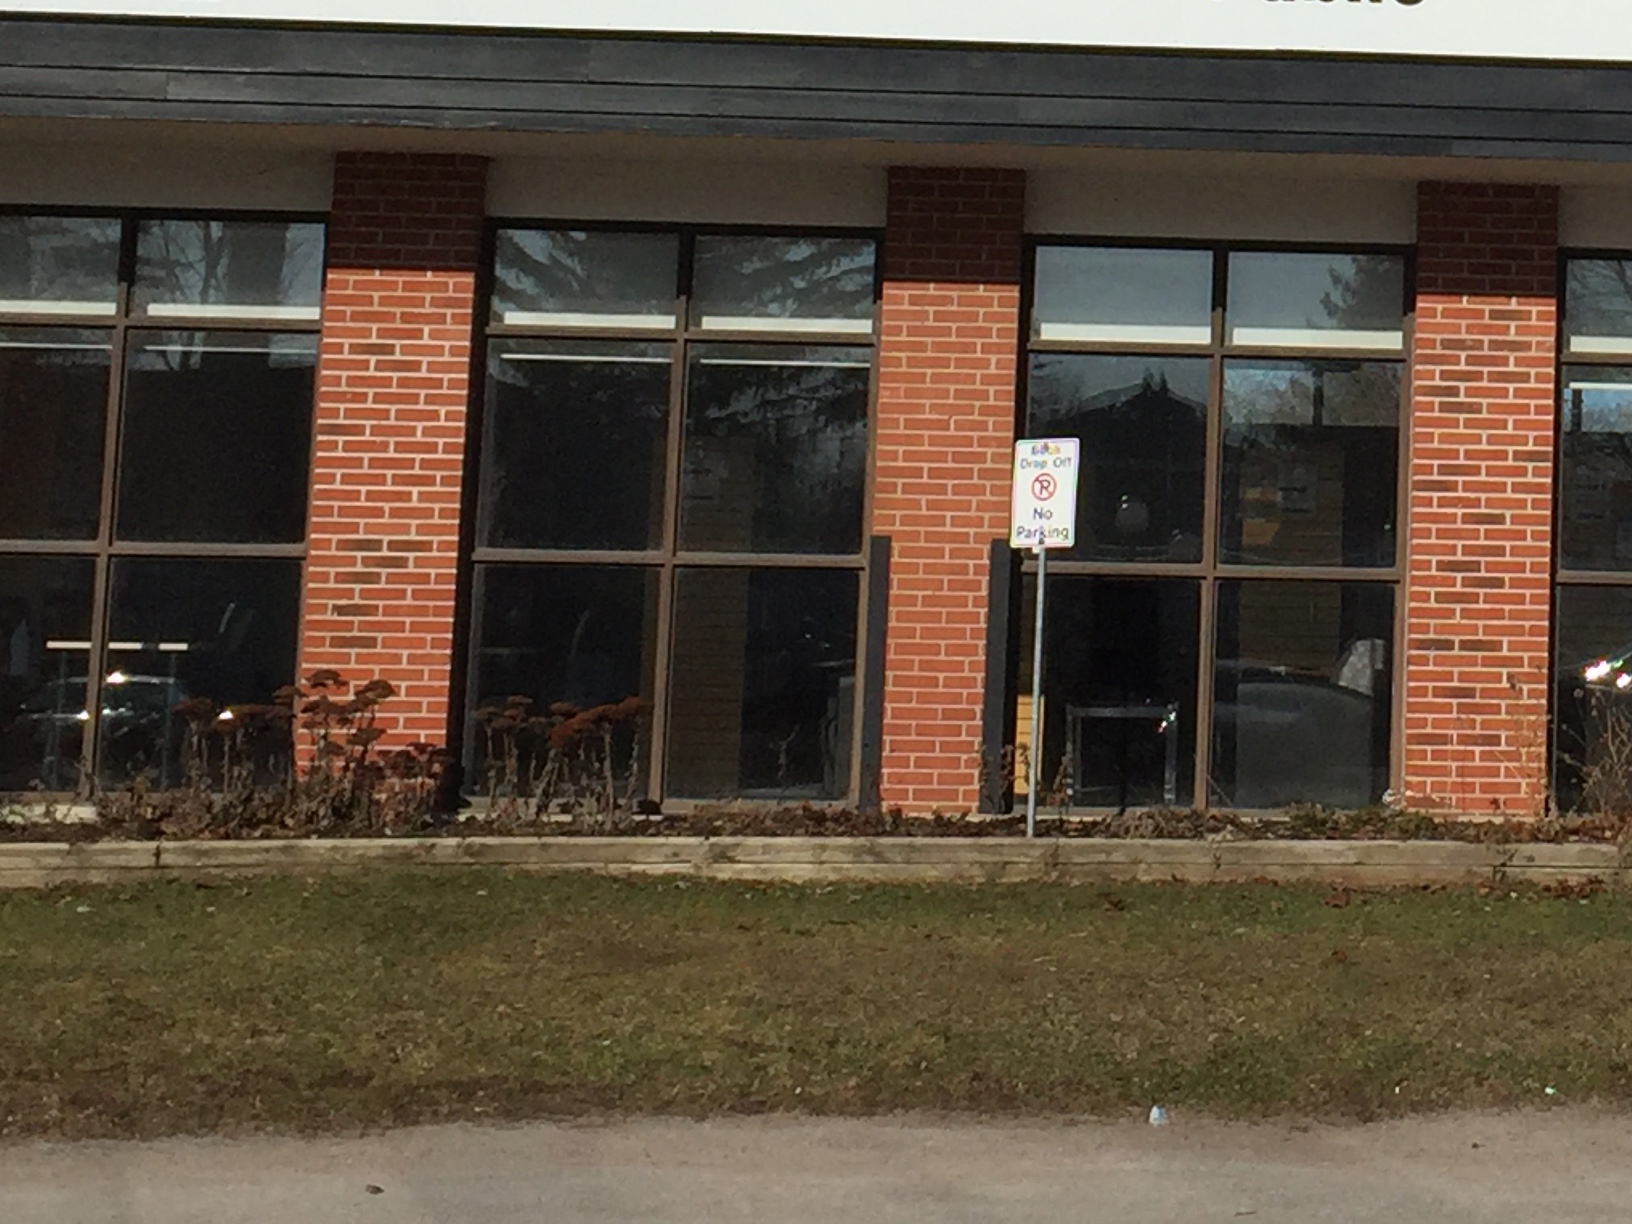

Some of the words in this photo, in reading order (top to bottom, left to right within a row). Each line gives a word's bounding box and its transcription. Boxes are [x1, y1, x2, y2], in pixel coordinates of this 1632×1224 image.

[1053, 456, 1072, 468] Off
[1032, 508, 1053, 521] No
[1016, 526, 1069, 541] Parking
